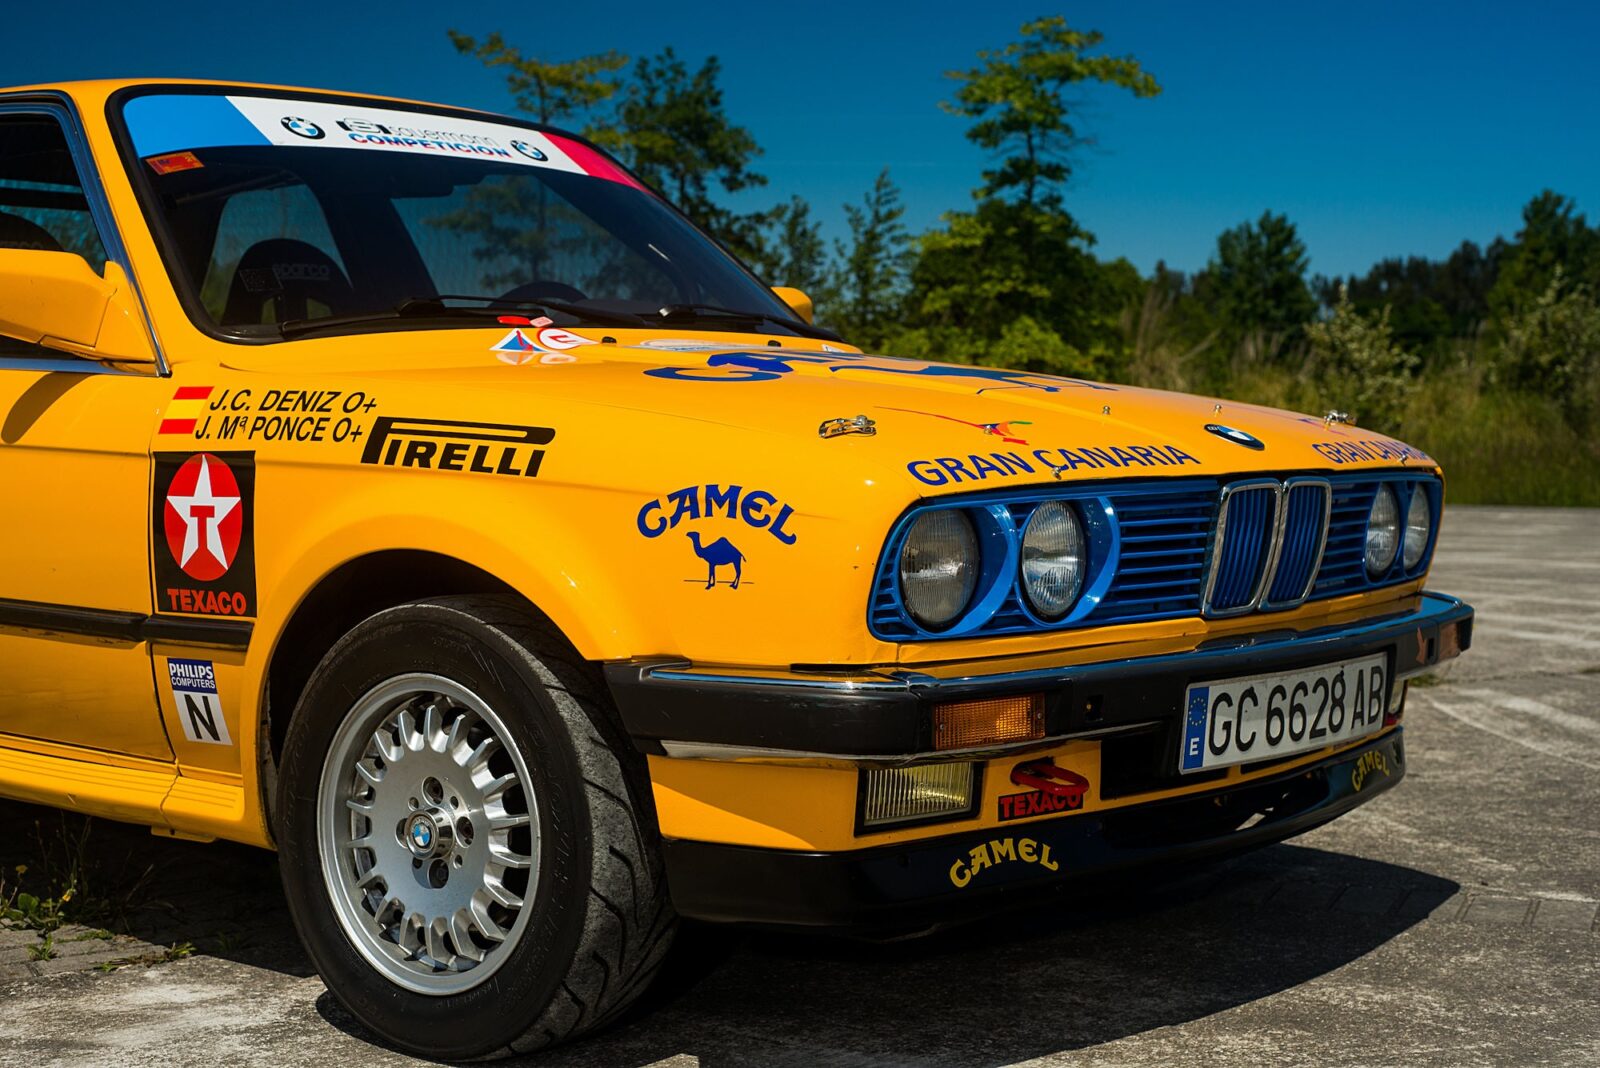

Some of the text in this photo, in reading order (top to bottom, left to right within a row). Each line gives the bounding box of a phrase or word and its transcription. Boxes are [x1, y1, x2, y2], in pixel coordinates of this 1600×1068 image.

[348, 133, 513, 158] COMPETICION
[209, 389, 378, 414] J.C. DENIZ O+
[248, 416, 331, 442] PONCE
[332, 417, 363, 443] O+
[360, 416, 556, 478] PIRELLI
[1312, 441, 1376, 464] GRAN
[906, 445, 1202, 486] GRAN CANARIA
[637, 484, 797, 545] CAMEL
[167, 588, 247, 615] TEXACO
[169, 663, 214, 680] PHILIPS
[171, 676, 216, 689] COMPUTERS
[184, 694, 221, 741] N
[1209, 665, 1384, 756] GC 6628 AB
[1189, 737, 1200, 756] E
[1351, 751, 1390, 791] CAMEL
[949, 838, 1059, 888] CAMEL
